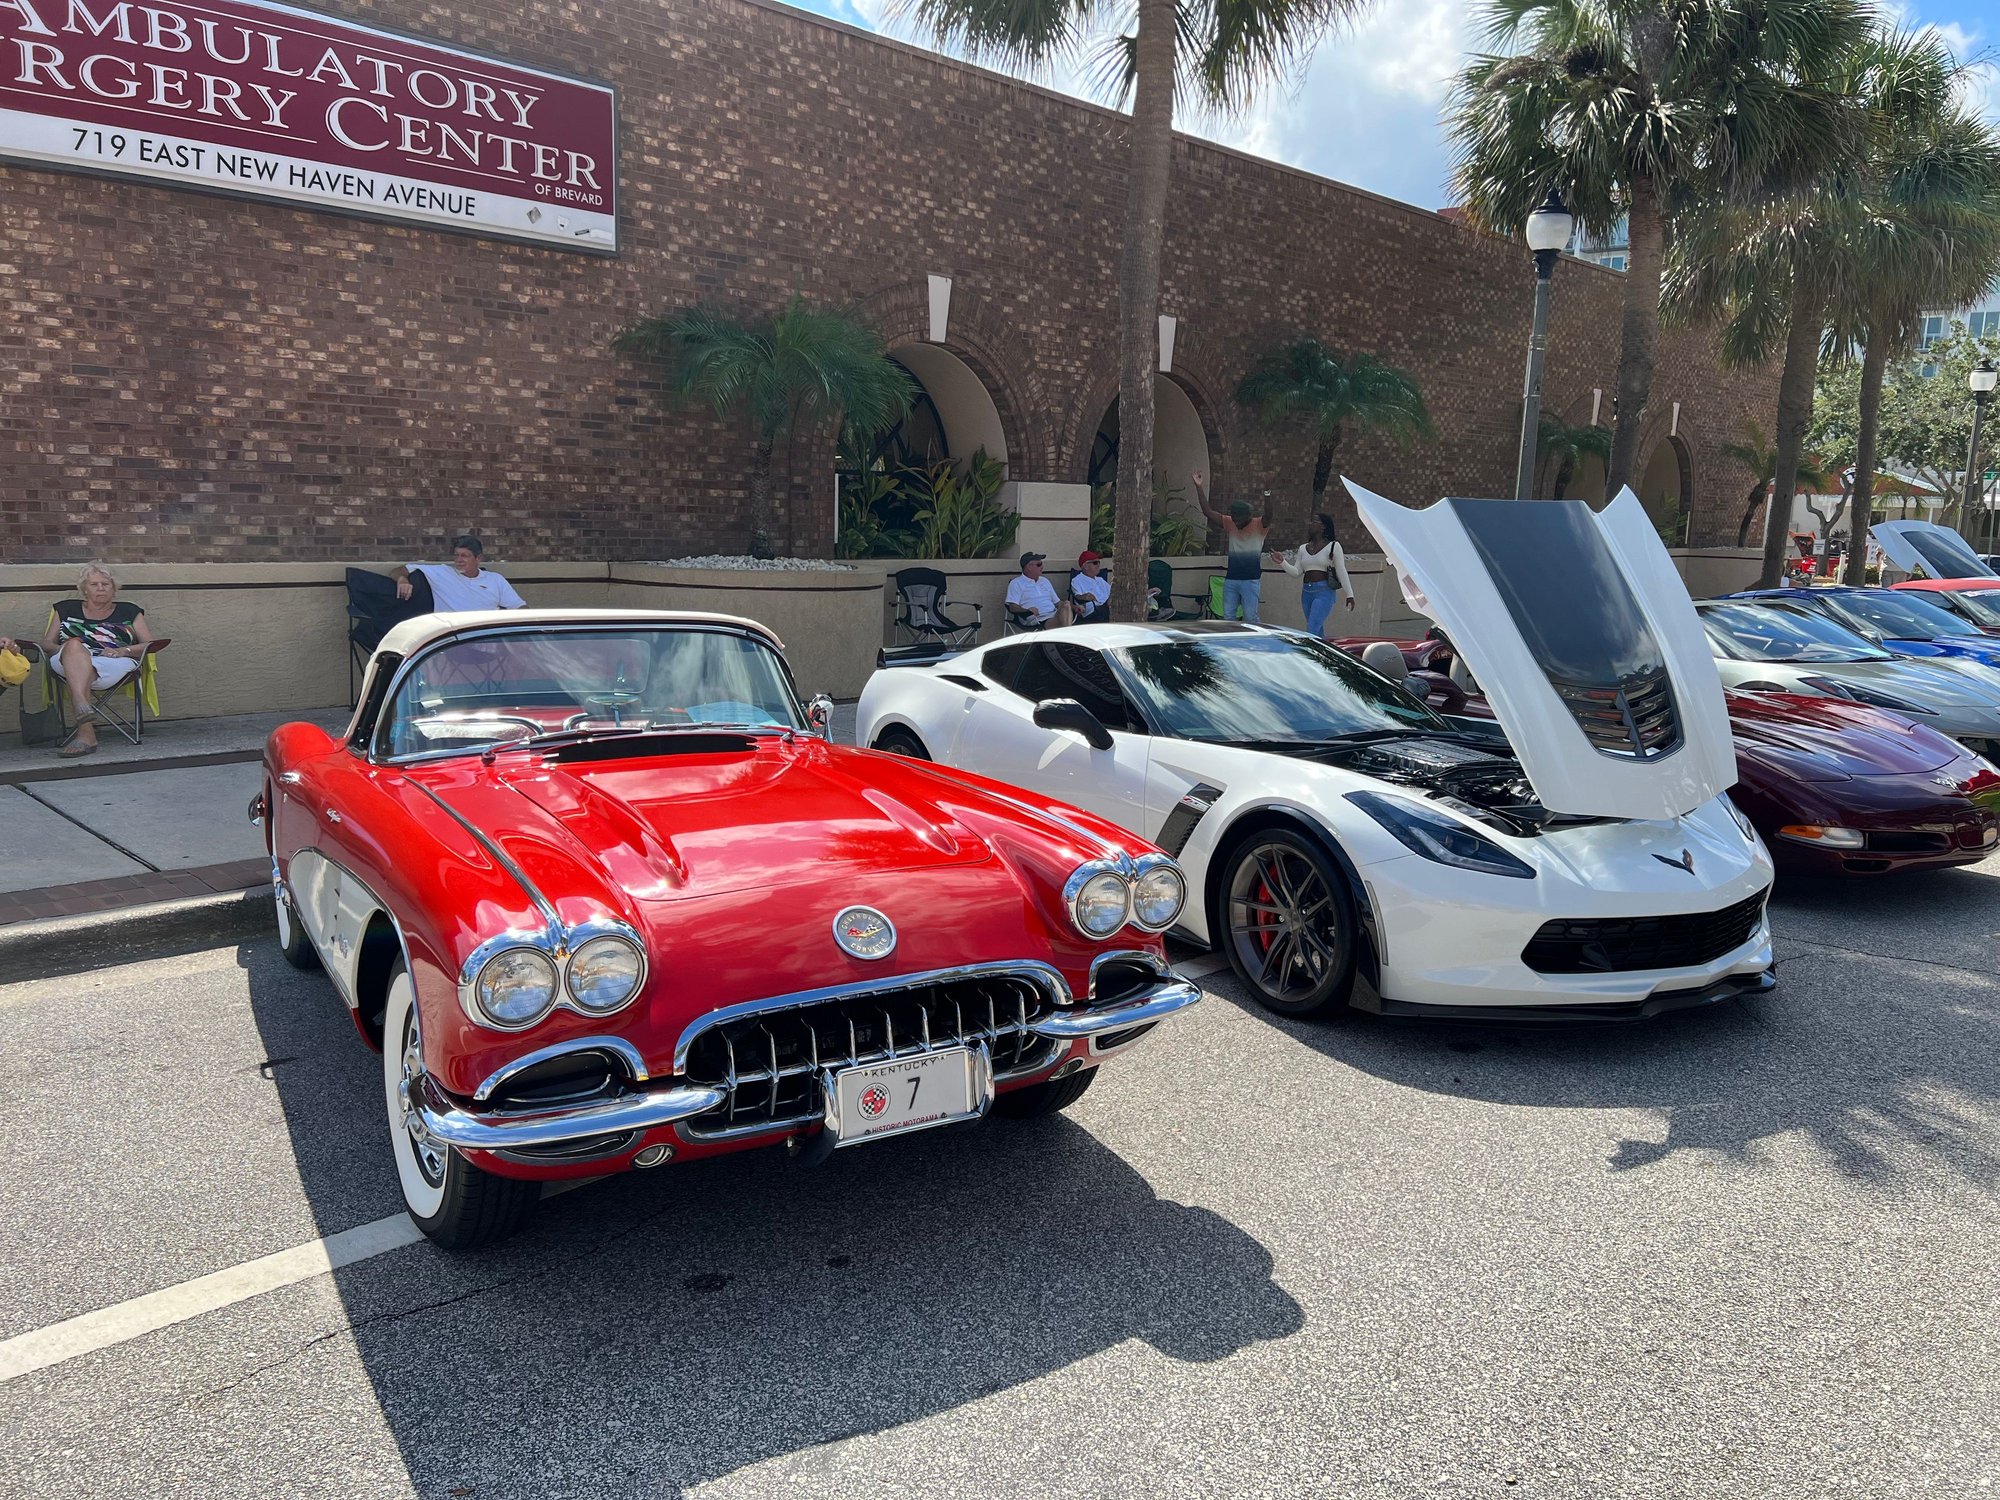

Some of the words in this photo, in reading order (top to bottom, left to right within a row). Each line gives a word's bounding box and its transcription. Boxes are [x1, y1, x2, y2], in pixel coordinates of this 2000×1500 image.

[0, 35, 299, 129] RGERY
[325, 96, 602, 190] CENTER
[72, 127, 127, 158] 719
[139, 138, 206, 170] EAST
[216, 151, 279, 182] NEW
[289, 164, 375, 199] HAVEN
[383, 182, 476, 217] AVENUE
[534, 182, 552, 197] OF
[555, 186, 603, 206] BREVARD
[841, 912, 882, 930] CHEVROLET
[850, 937, 888, 953] CORVETTE
[871, 1056, 937, 1078] KENTUCKY
[906, 1076, 921, 1111] 7
[871, 1121, 902, 1134] HISTORIC
[902, 1113, 939, 1127] MOTORAMA
